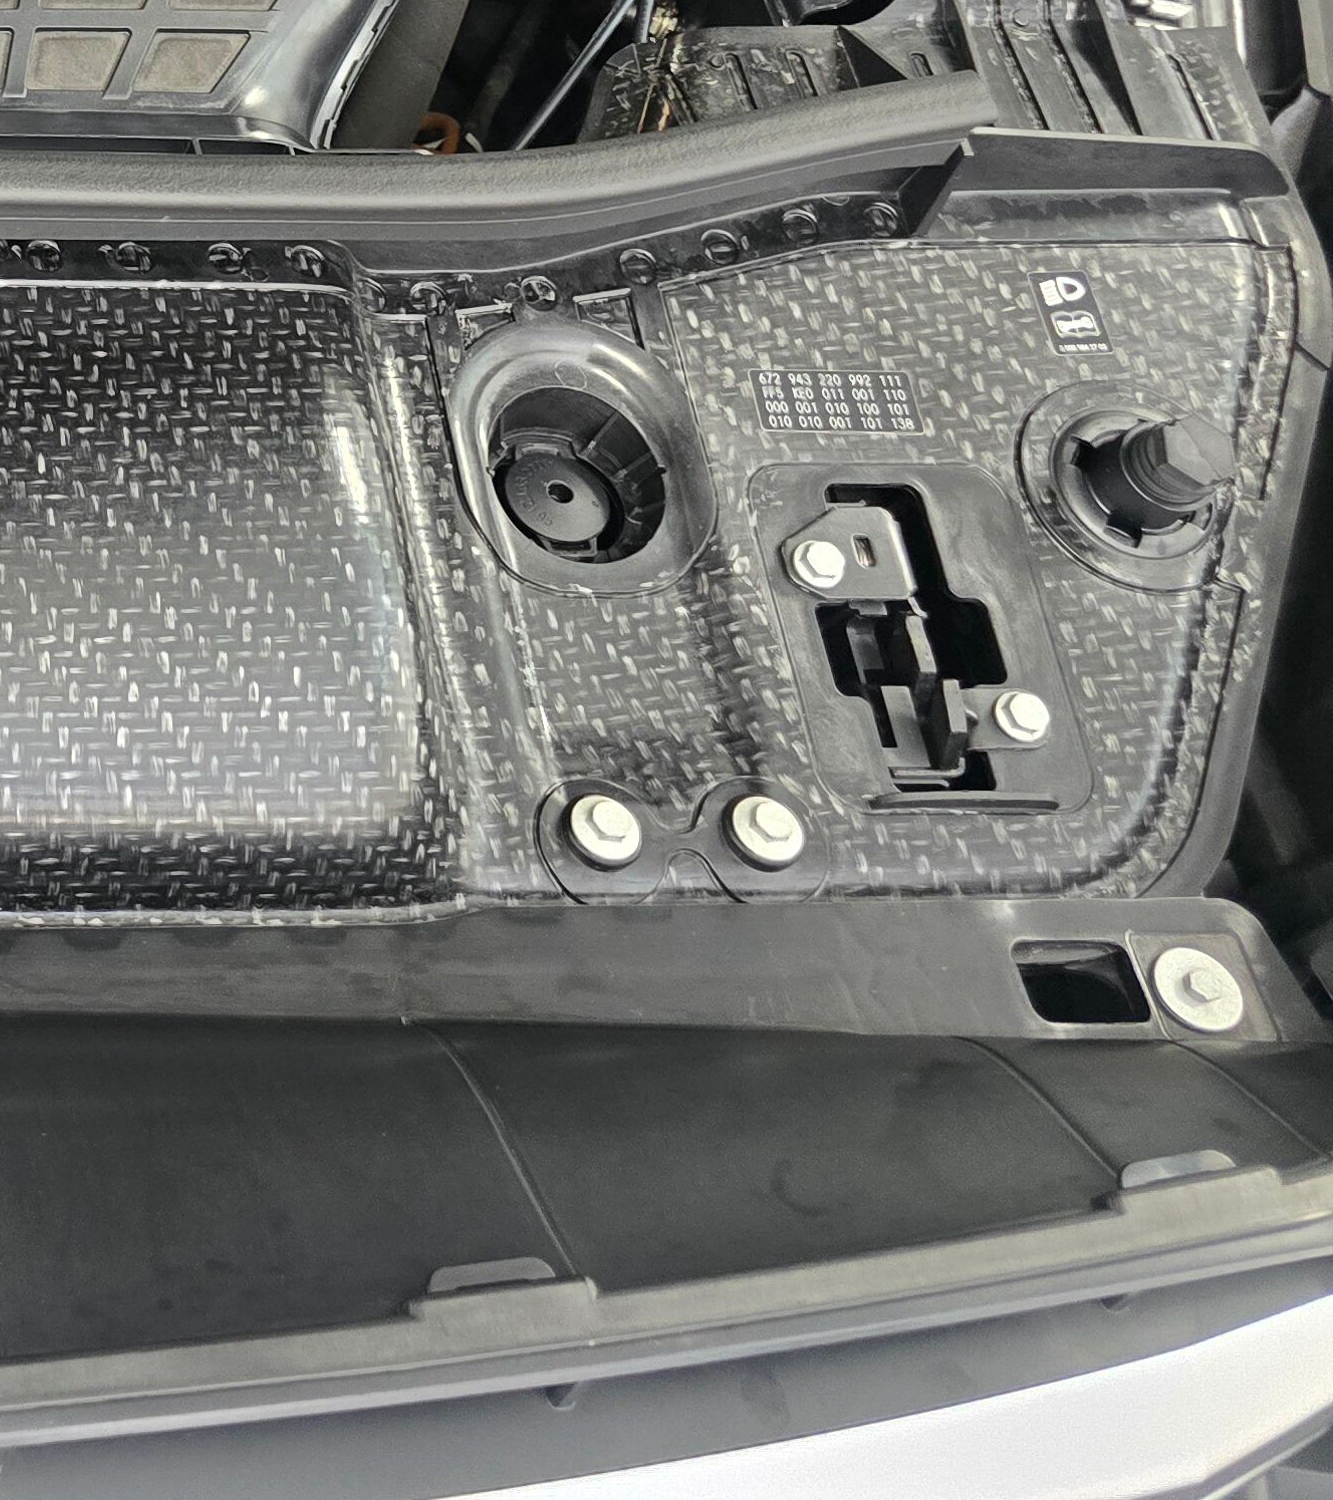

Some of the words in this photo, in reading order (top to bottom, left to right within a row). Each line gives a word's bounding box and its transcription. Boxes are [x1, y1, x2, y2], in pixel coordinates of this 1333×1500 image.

[758, 372, 782, 386] 672
[787, 373, 813, 387] 943
[817, 373, 842, 387] 220
[848, 373, 872, 387] 992
[879, 375, 902, 388] 111
[821, 388, 845, 401] 011
[851, 388, 875, 401] 001
[883, 389, 907, 402] 110
[764, 401, 789, 414] 000
[795, 401, 818, 414] 001
[825, 402, 850, 415] 010
[857, 403, 880, 416] 100
[887, 403, 910, 416] 101
[768, 414, 793, 428] 010
[798, 415, 823, 429] 010
[829, 416, 853, 429] 001
[861, 417, 883, 430] 101
[891, 418, 915, 430] 138
